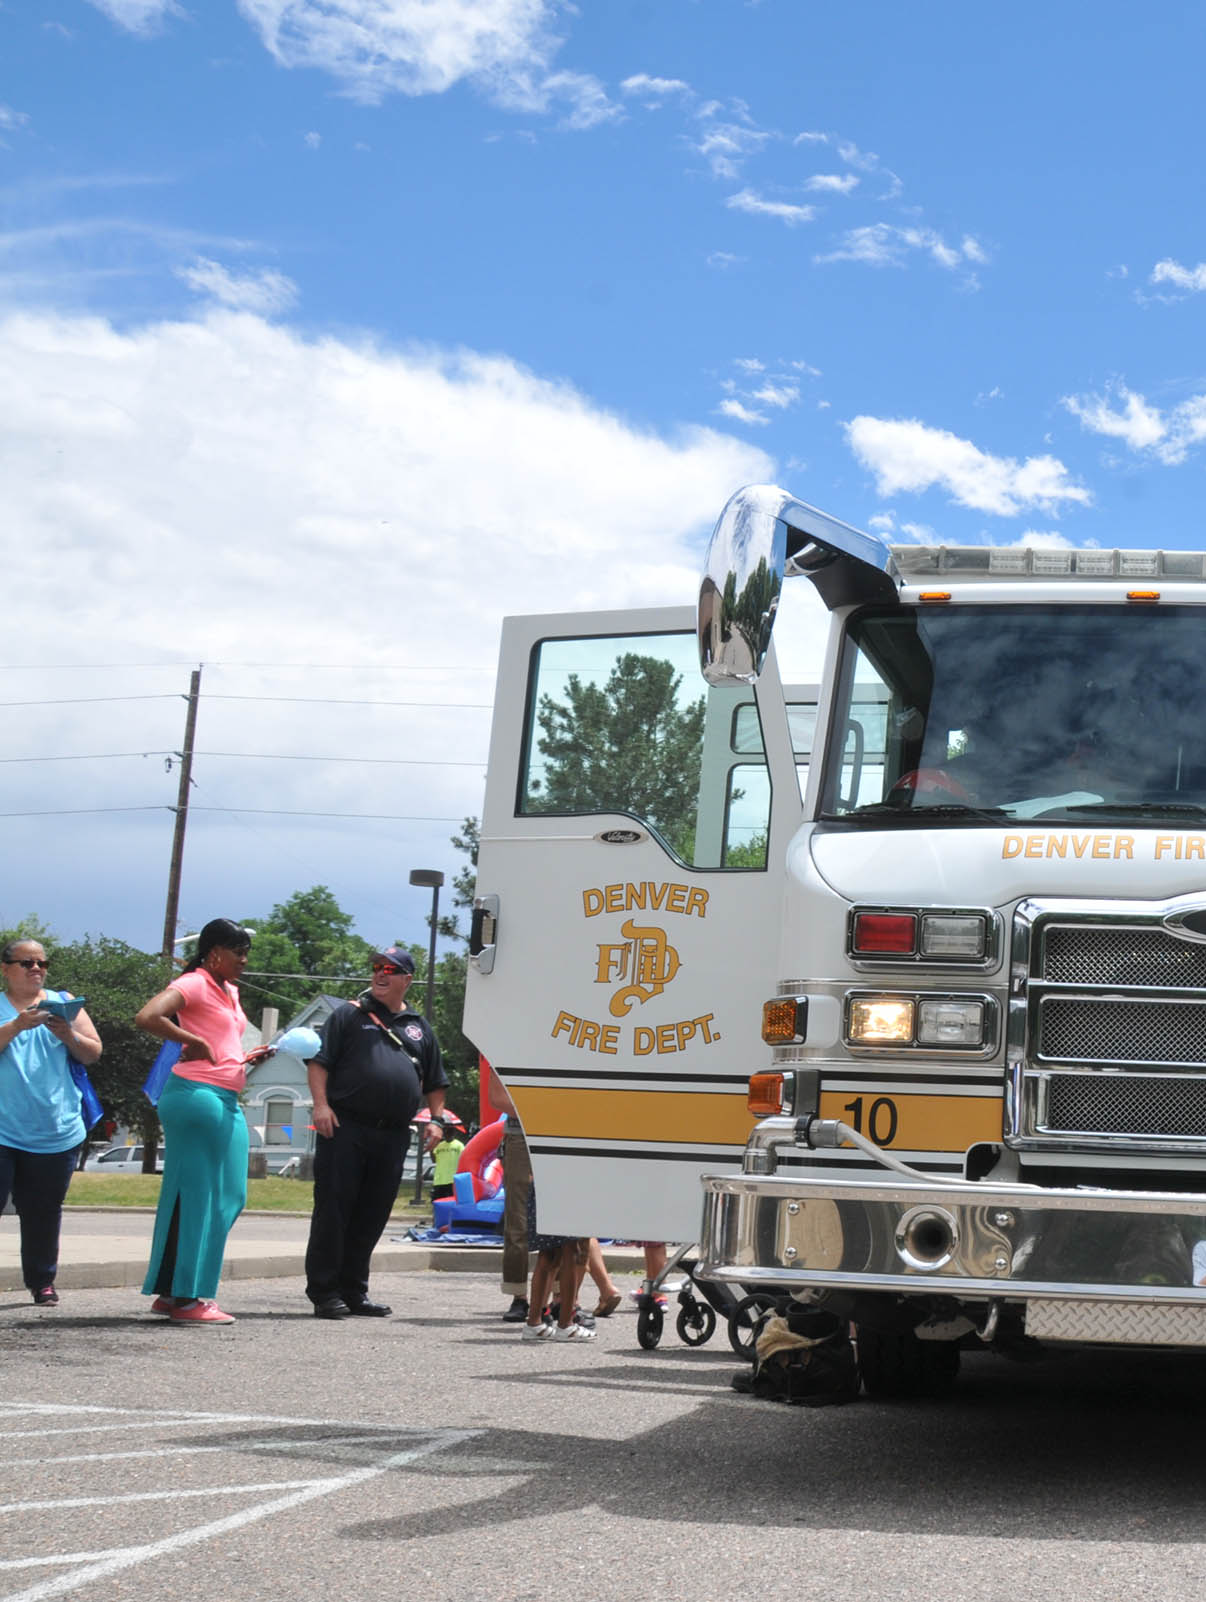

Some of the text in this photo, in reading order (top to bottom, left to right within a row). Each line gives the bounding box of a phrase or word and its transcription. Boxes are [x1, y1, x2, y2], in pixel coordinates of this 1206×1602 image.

[1002, 835, 1135, 859] DENVER
[583, 882, 710, 918] DENVER
[551, 1010, 721, 1056] FIRE DEPT.
[844, 1096, 898, 1146] 10
